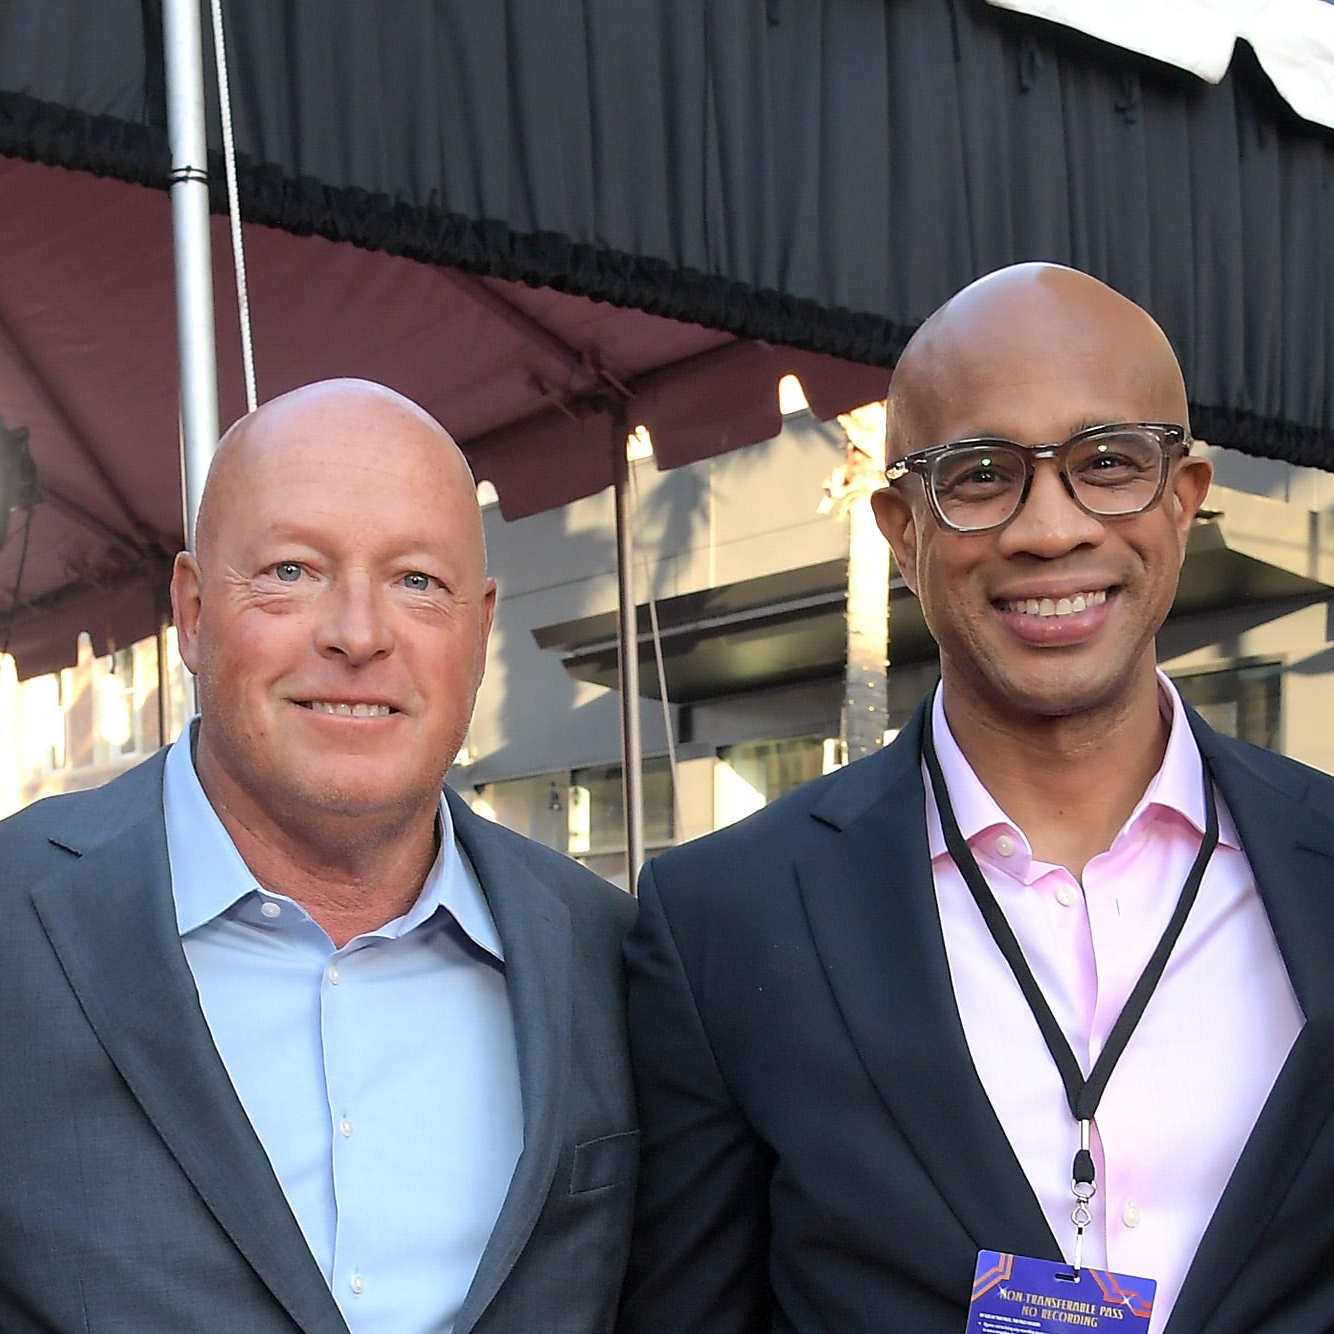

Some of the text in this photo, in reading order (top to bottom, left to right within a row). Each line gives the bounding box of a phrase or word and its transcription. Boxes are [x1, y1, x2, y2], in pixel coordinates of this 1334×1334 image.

[1000, 1290, 1124, 1319] NON-TRANSFERABLE PASS
[1021, 1305, 1038, 1317] NO
[1041, 1309, 1098, 1328] RECORDING
